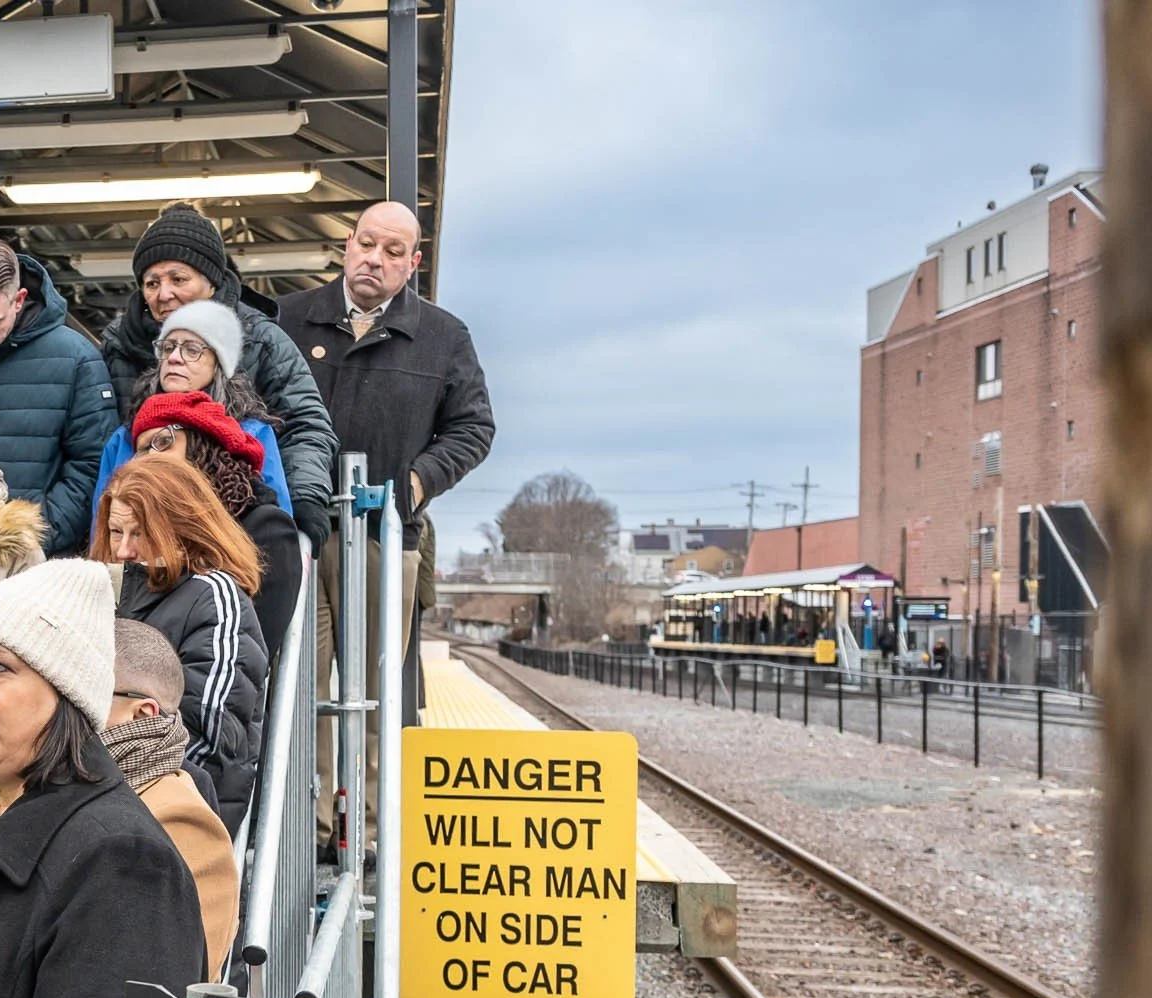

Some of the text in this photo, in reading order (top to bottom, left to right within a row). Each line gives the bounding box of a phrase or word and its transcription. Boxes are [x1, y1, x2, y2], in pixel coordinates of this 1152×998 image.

[424, 756, 602, 792] DANGER
[424, 814, 602, 850] WILL NOT
[412, 861, 626, 900] CLEAR MAN
[436, 910, 582, 947] ON SIDE
[443, 958, 578, 996] OF CAR
